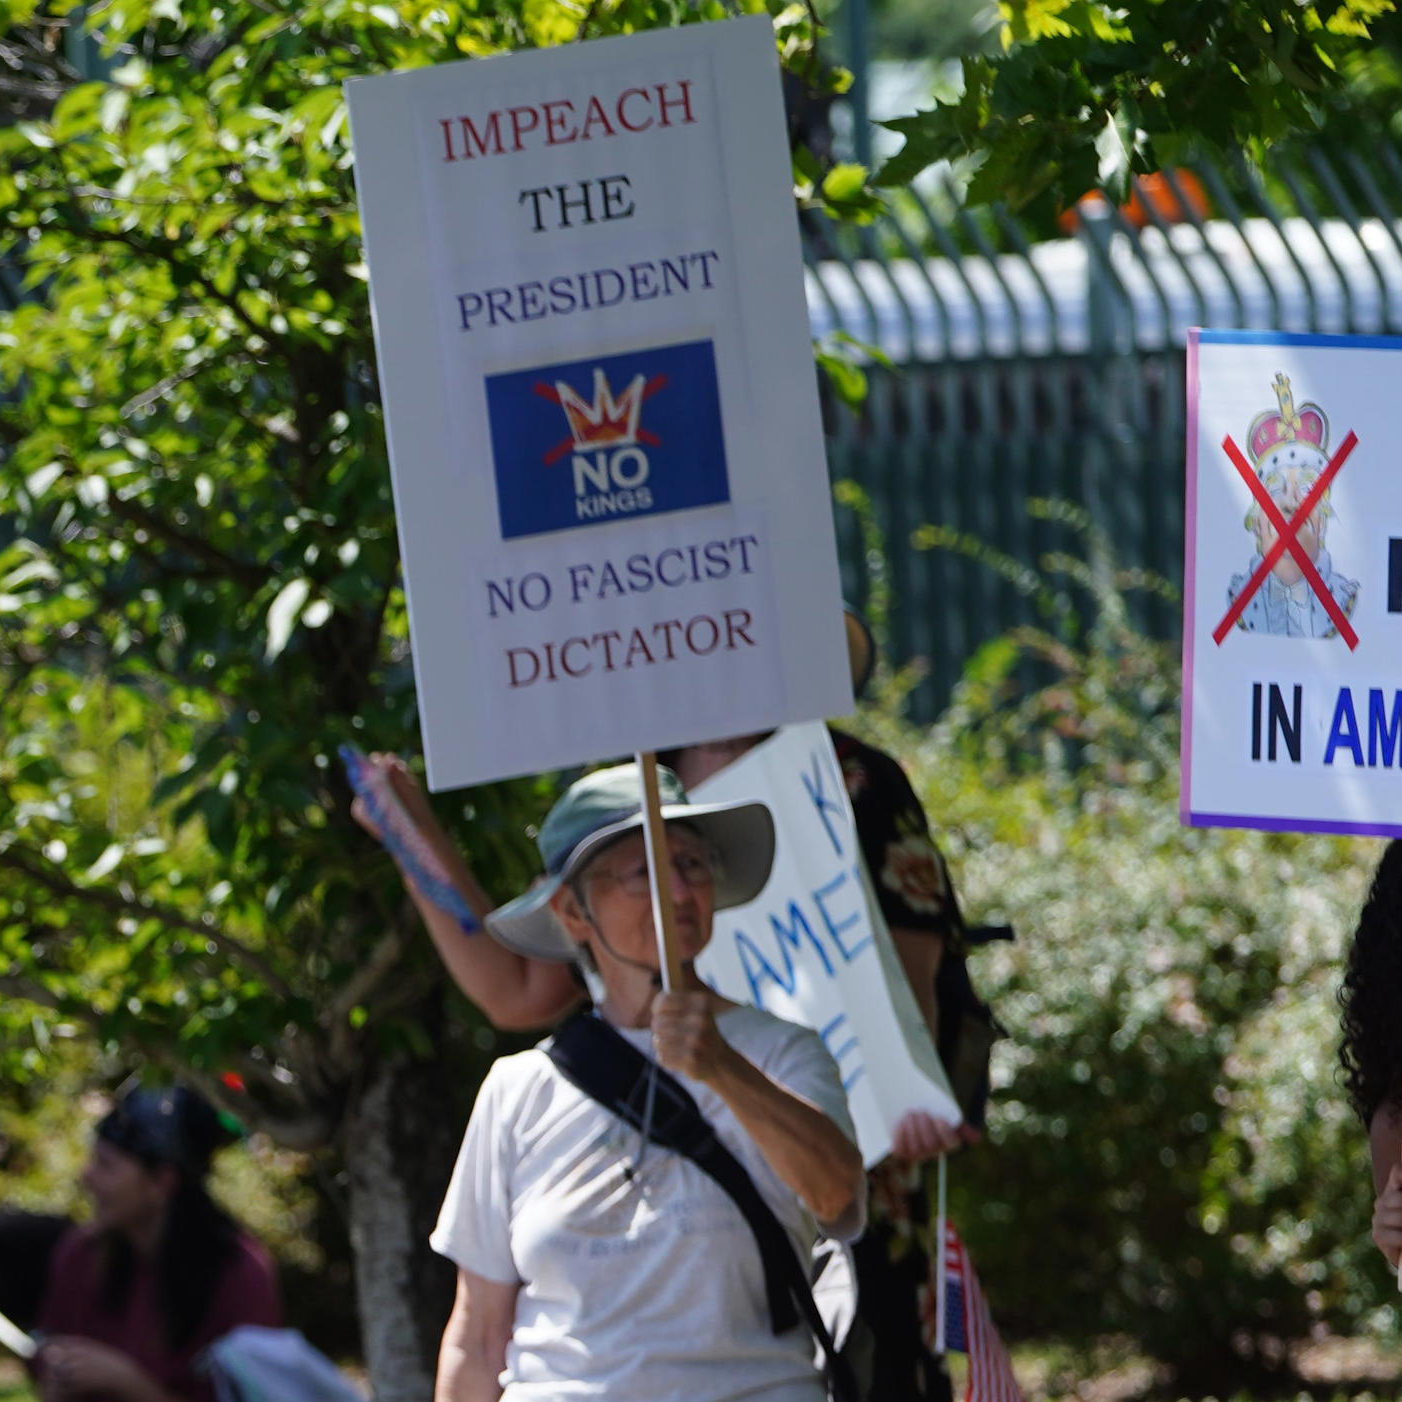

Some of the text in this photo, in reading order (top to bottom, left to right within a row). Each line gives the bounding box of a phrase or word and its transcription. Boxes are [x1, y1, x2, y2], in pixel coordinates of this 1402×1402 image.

[439, 79, 697, 164] IMPEACH
[519, 174, 636, 233] THE
[456, 250, 721, 332] PRESIDENT
[571, 446, 651, 498] NO
[574, 486, 654, 521] KINGS
[484, 534, 759, 618] NO FASCIST
[505, 607, 756, 690] DICTATOR
[1251, 681, 1303, 763] IN
[733, 863, 878, 1012] AME
